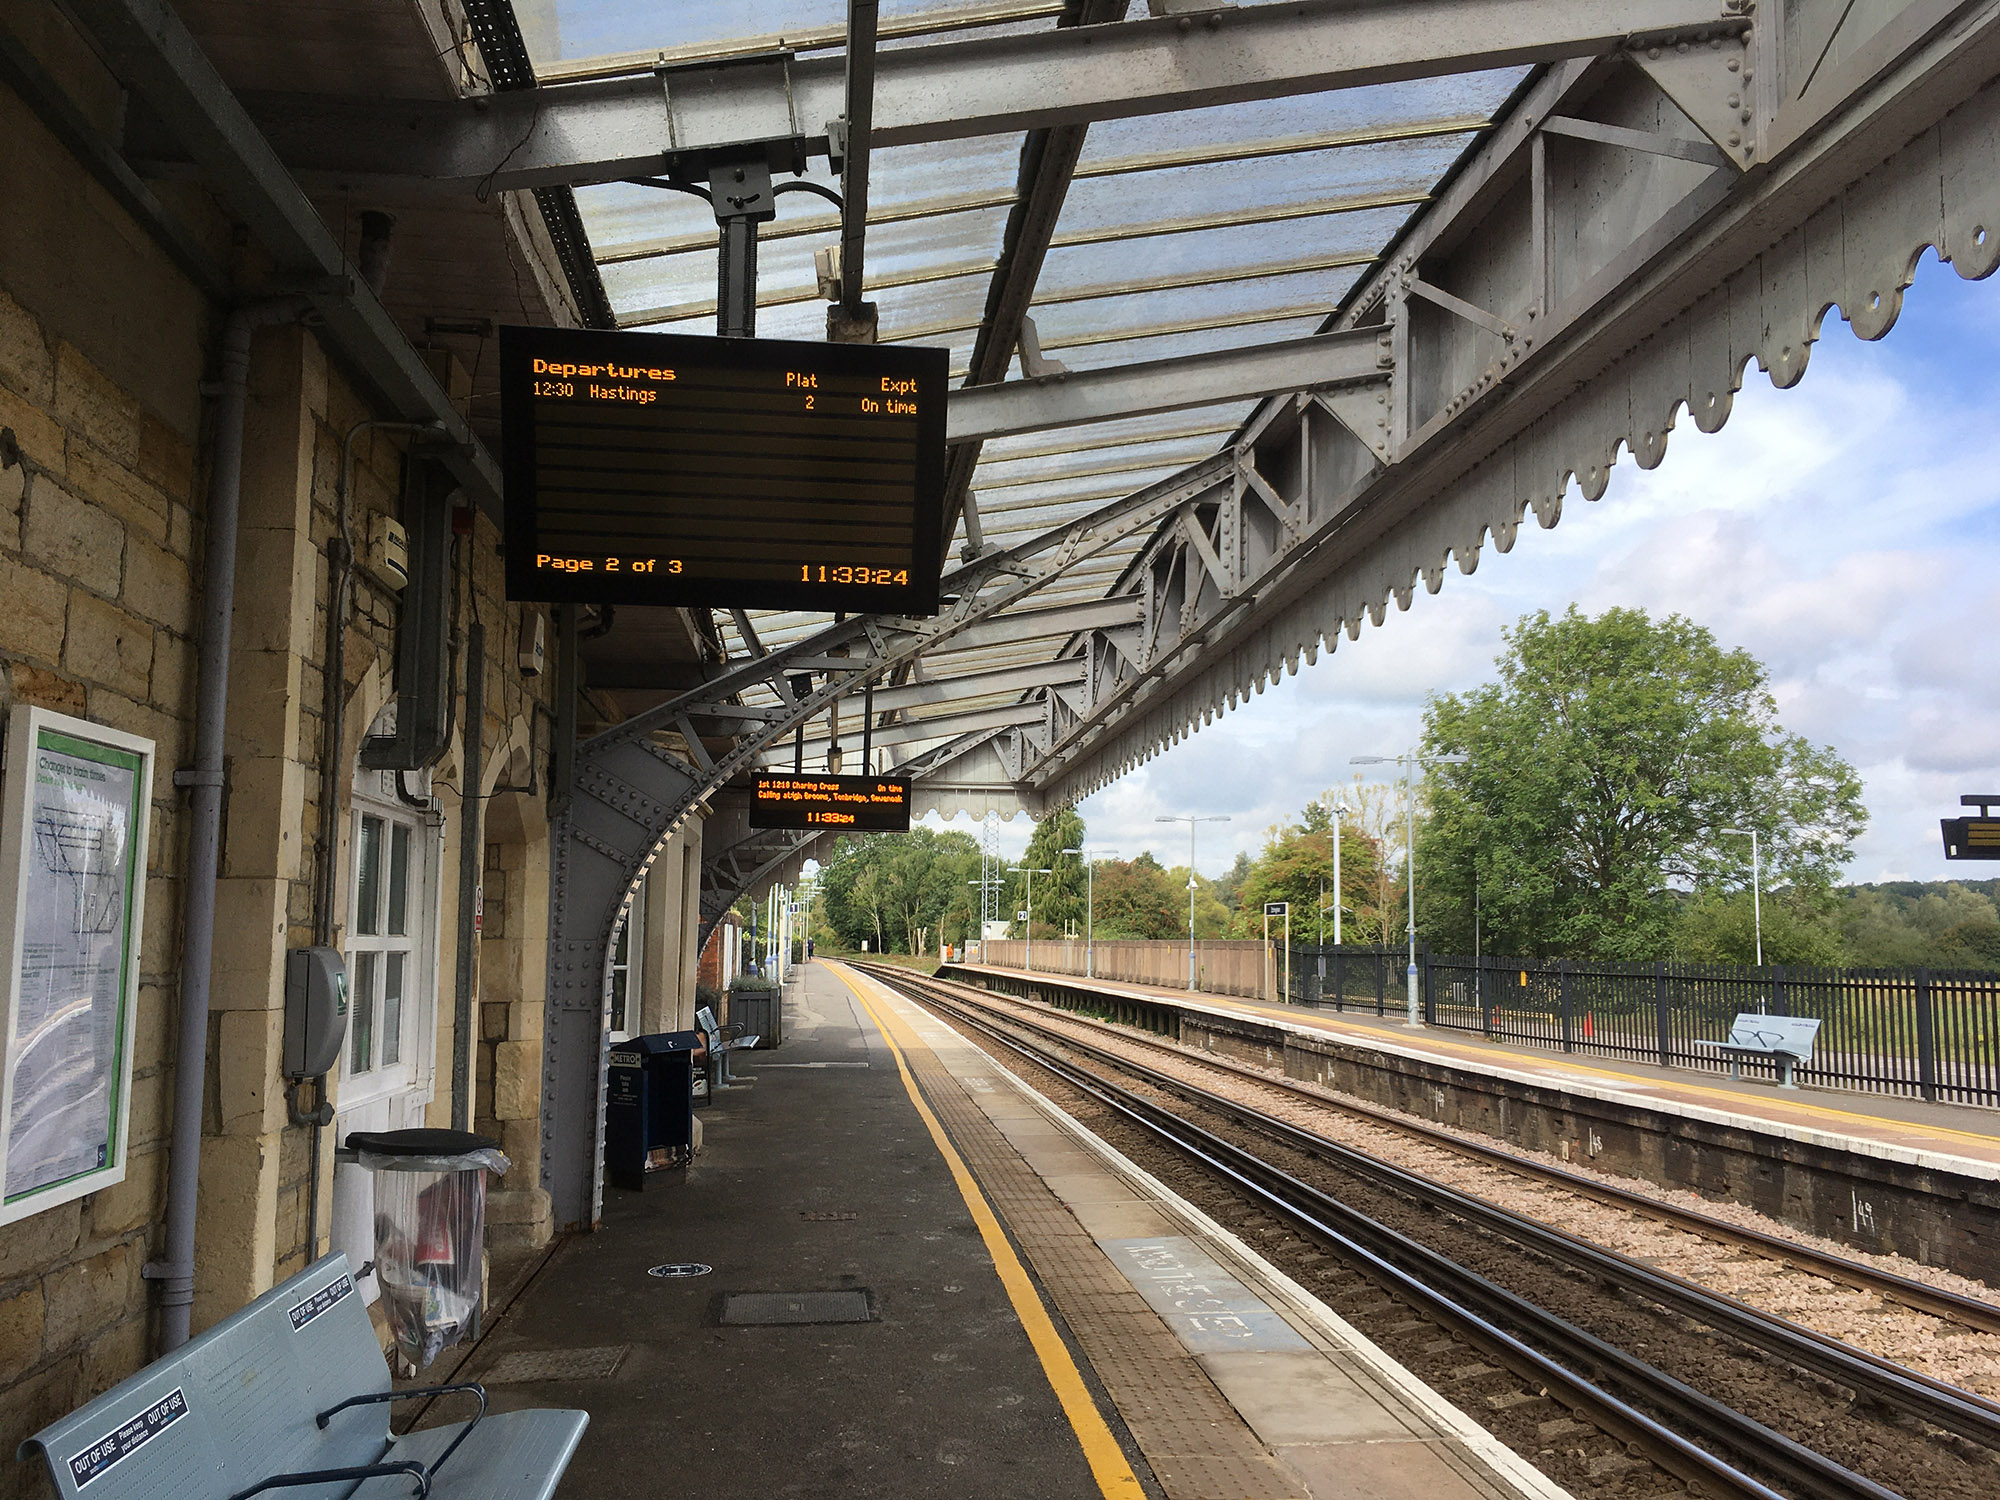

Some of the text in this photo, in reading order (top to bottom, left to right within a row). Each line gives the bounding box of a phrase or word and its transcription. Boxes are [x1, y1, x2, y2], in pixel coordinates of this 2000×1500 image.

[533, 358, 677, 381] Departures
[786, 371, 918, 395] Plat Expt
[534, 381, 917, 415] 12:30 Hastings 2 On time
[536, 554, 683, 574] Page 2 of 3
[801, 564, 909, 586] 11:33:24
[39, 756, 65, 775] Changes
[73, 765, 88, 779] train
[89, 769, 106, 782] times
[758, 780, 770, 788] 1st
[792, 782, 818, 791] Charing
[819, 782, 840, 791] Cross
[877, 784, 887, 792] On
[888, 784, 903, 793] time
[758, 790, 781, 800] Calling
[807, 811, 856, 824] 11:33:24
[147, 1408, 161, 1425] OUT
[160, 1402, 170, 1416] OF
[168, 1394, 182, 1410] USE
[118, 1420, 144, 1440] Please keep
[120, 1429, 149, 1454] your distance
[75, 1456, 91, 1474] OUT
[90, 1448, 101, 1464] OF
[100, 1439, 116, 1456] USE
